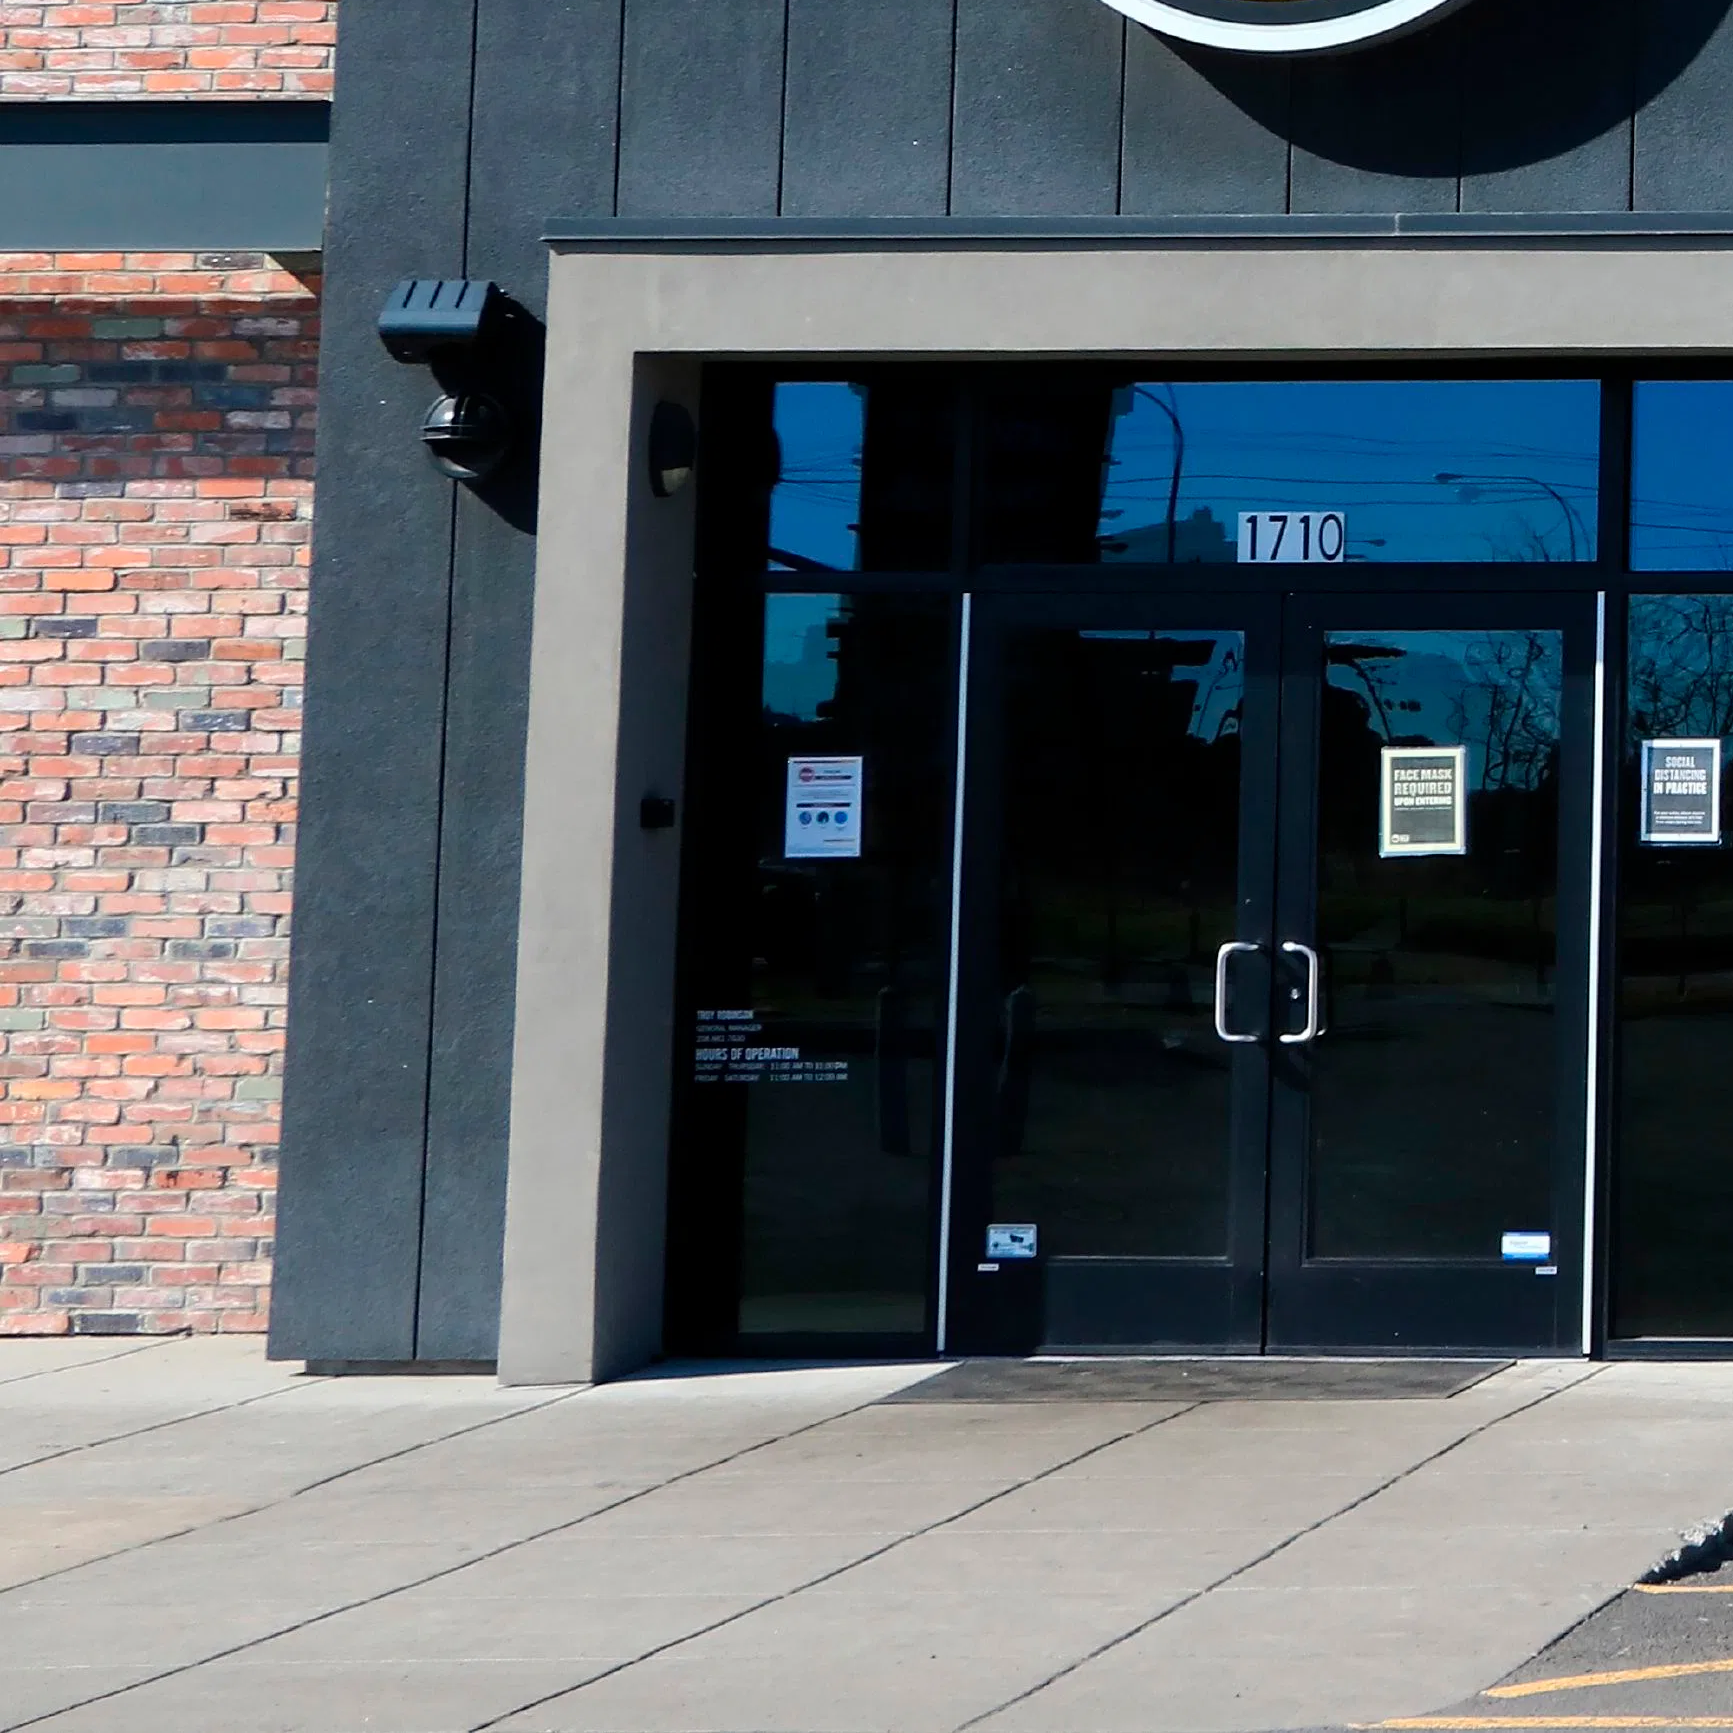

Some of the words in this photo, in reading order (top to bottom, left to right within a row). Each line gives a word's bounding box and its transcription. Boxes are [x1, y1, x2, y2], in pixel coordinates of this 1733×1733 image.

[1246, 513, 1343, 561] 1710
[1665, 756, 1695, 768] SOCIAL
[1394, 769, 1420, 781] FACE
[1421, 769, 1453, 780] MASK
[1654, 769, 1707, 781] DISTANCING
[1394, 782, 1453, 796] REQUIRED
[1653, 782, 1664, 795] IN
[1666, 782, 1708, 795] PRACTICE
[1394, 796, 1415, 806] UPON
[1416, 796, 1453, 806] ENTERING
[695, 1048, 728, 1061] HOURS
[731, 1048, 742, 1060] OF
[745, 1047, 800, 1060] OPERATION
